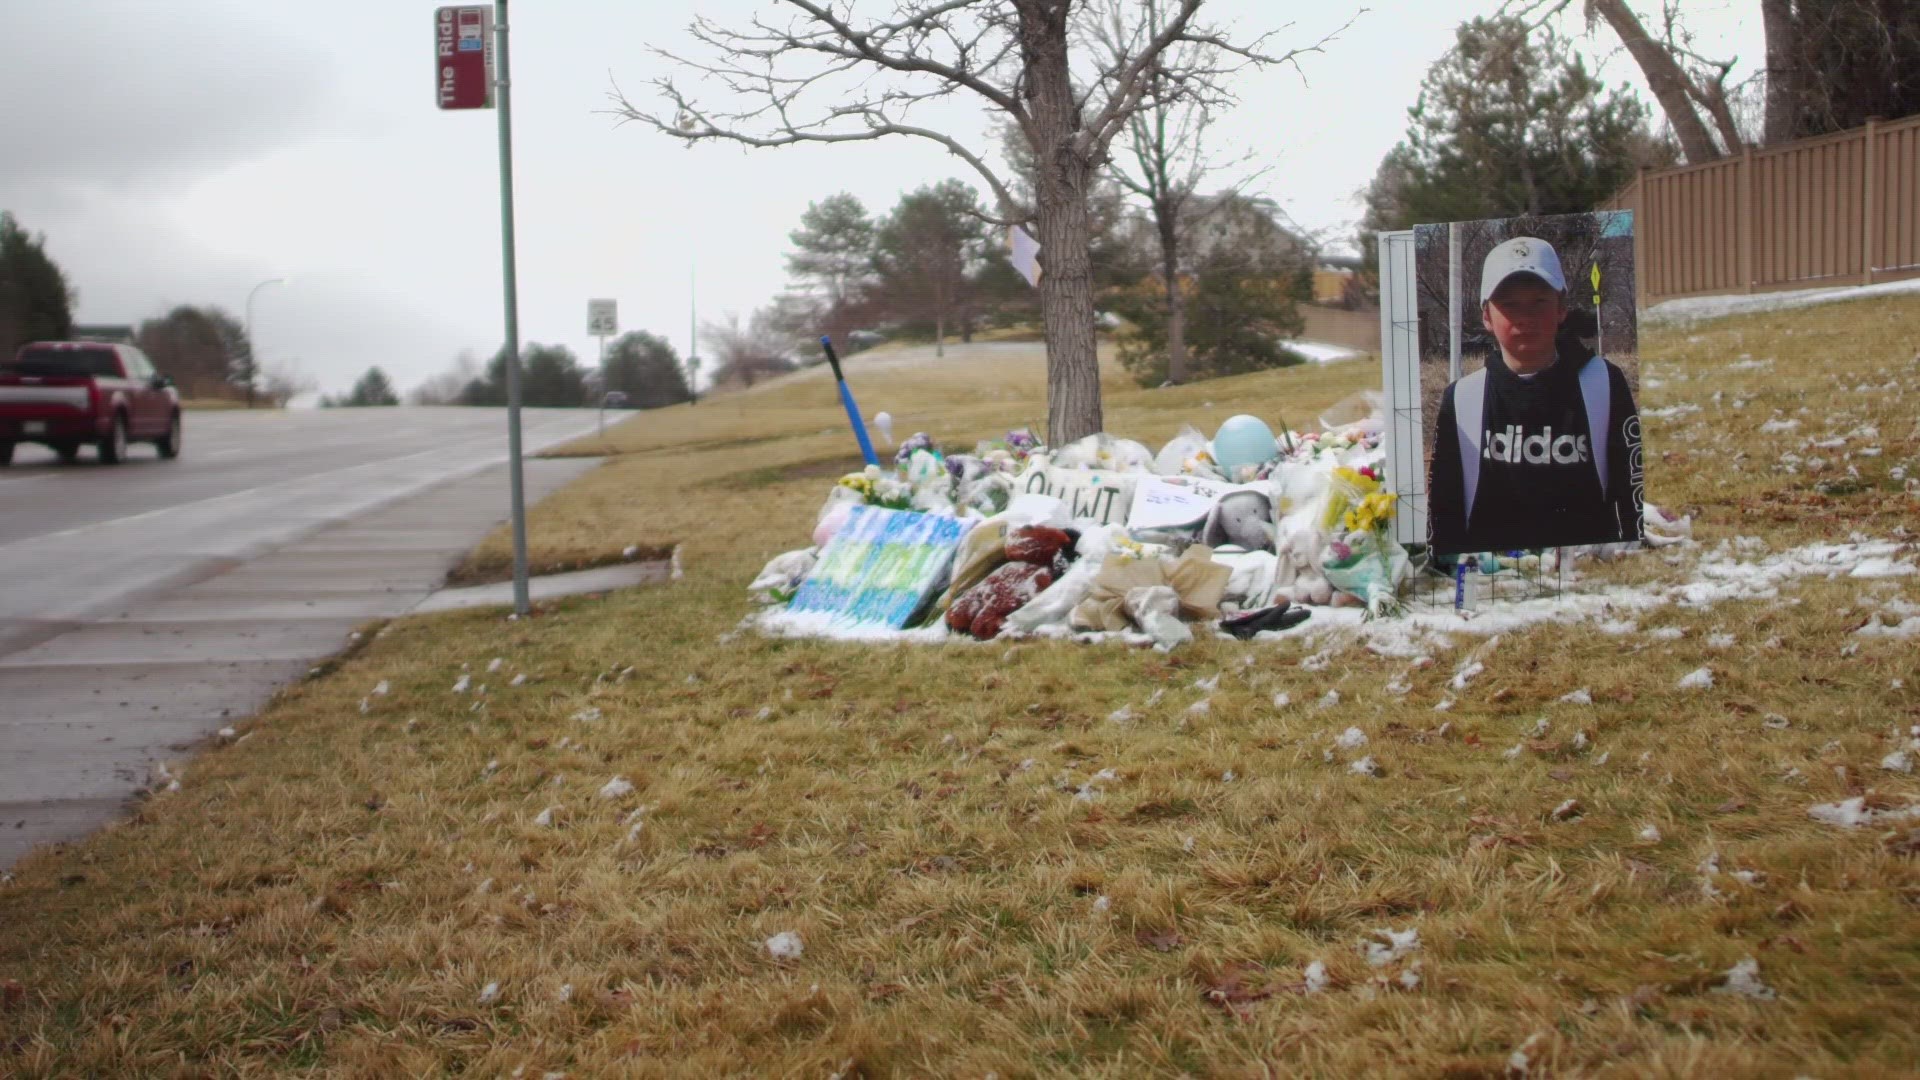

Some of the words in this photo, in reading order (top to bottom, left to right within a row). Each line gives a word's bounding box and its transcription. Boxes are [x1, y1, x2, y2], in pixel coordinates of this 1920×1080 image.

[439, 9, 453, 56] Ride
[440, 66, 455, 104] The
[1483, 424, 1588, 464] didas
